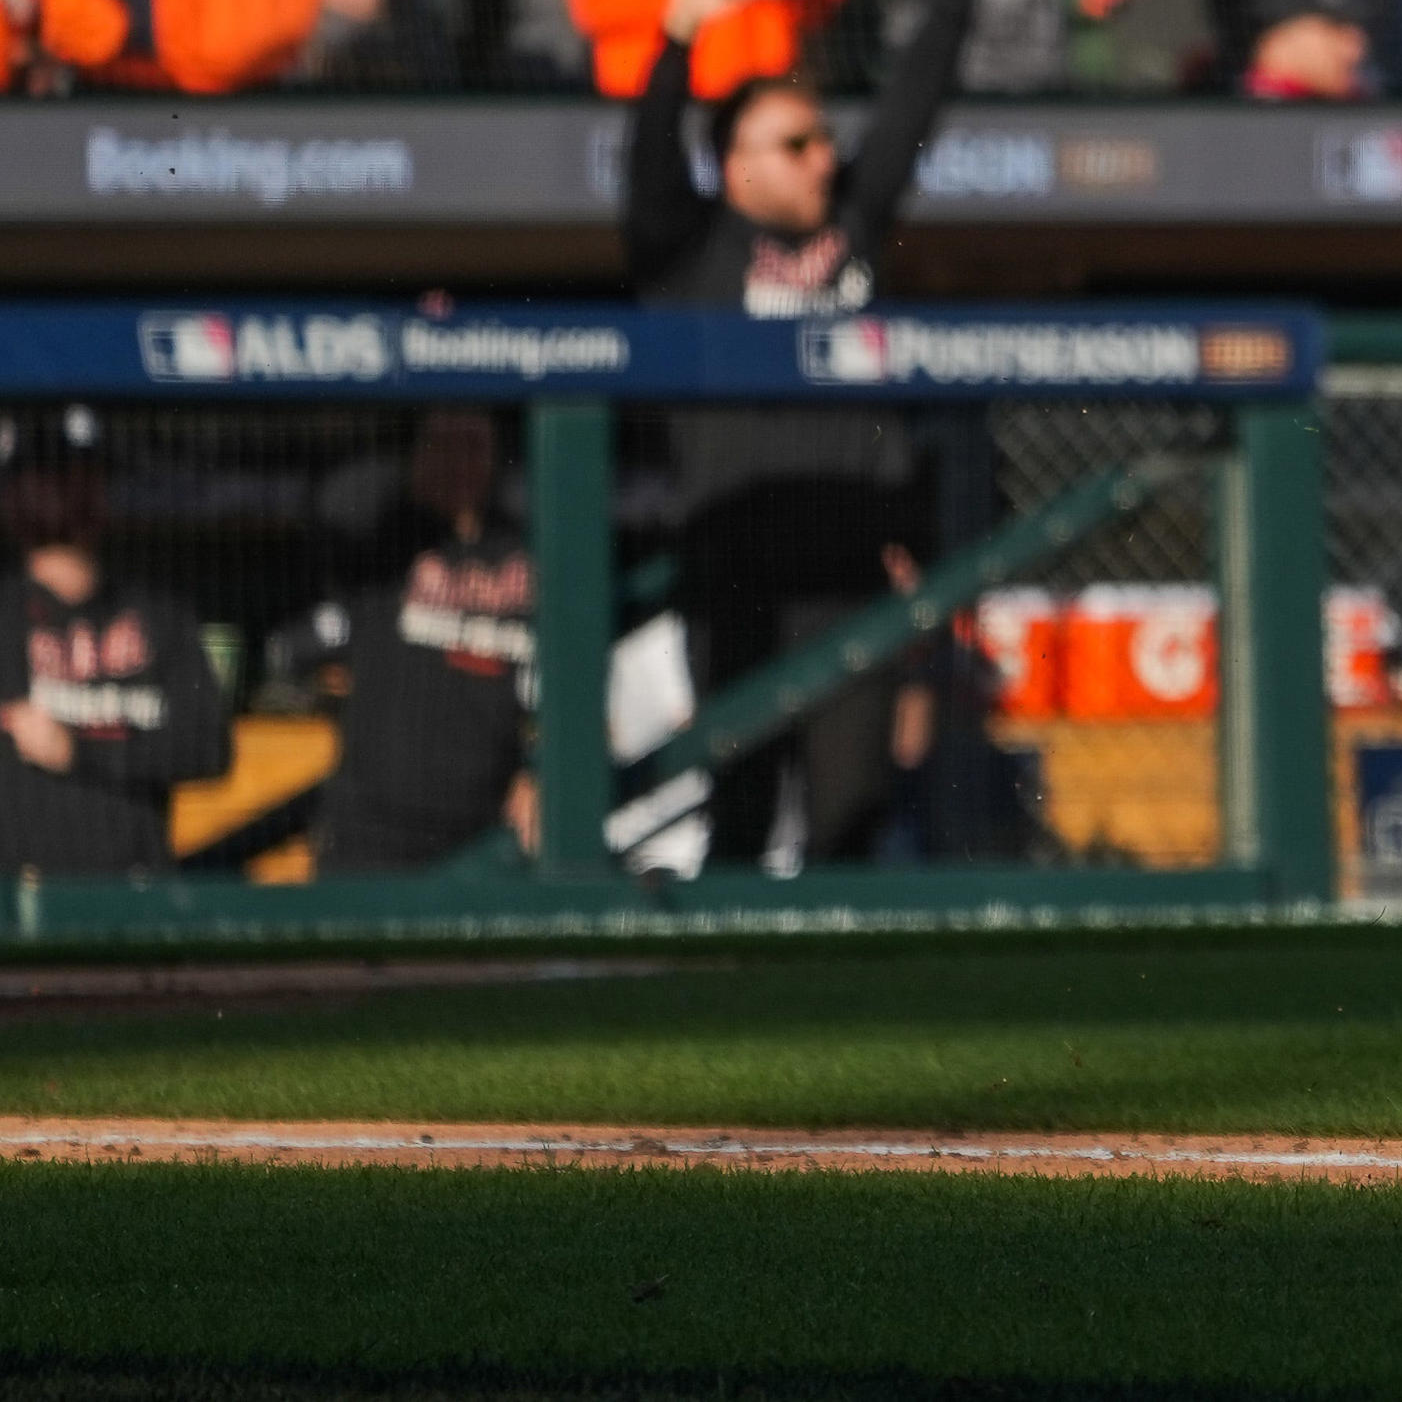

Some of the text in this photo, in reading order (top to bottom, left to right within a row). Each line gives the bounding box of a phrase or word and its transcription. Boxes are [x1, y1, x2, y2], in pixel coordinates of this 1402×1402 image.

[86, 127, 412, 207] Booking.com
[238, 315, 630, 381] ALDS Booking.com
[889, 317, 1199, 384] POSTSEASON
